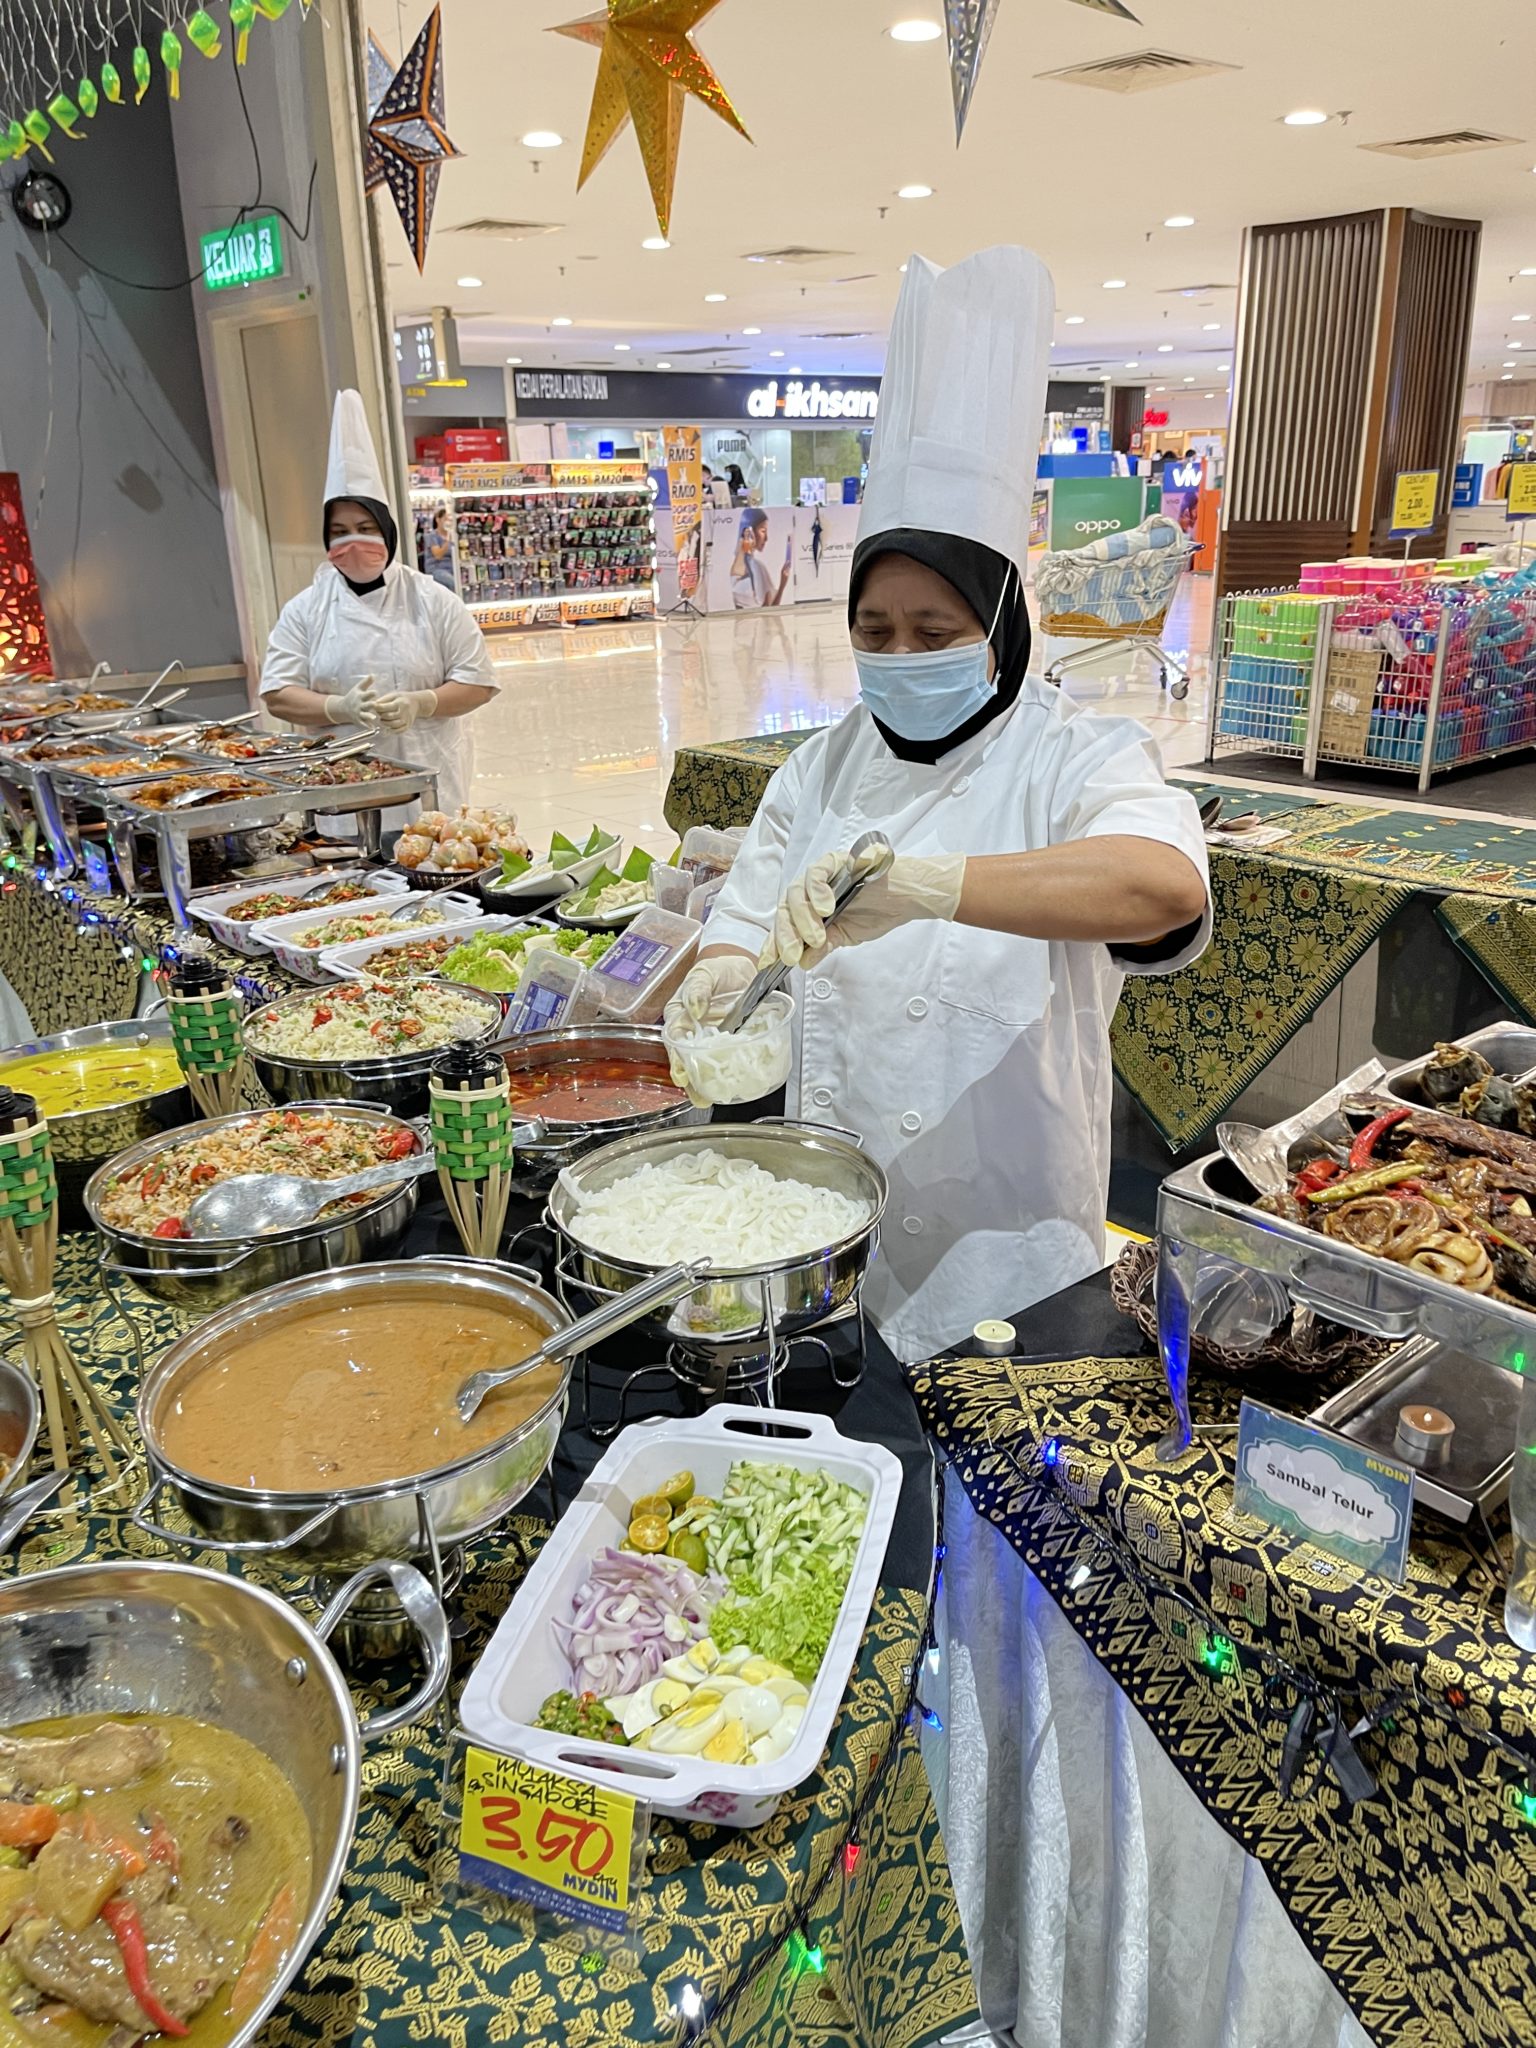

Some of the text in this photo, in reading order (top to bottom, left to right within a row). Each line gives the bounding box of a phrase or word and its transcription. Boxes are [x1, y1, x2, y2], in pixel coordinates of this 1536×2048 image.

[204, 233, 258, 281] KELUAR
[515, 373, 608, 399] KEDAI PERALATAN SUKAN
[668, 448, 695, 462] RM15
[717, 439, 747, 452] PUMA
[559, 474, 622, 485] RM15 RM20
[1172, 463, 1203, 487] viv
[713, 516, 733, 525] vivo
[1074, 519, 1121, 534] oppo
[492, 609, 522, 622] CABLE
[568, 602, 618, 616] FREE CABLE
[1365, 1457, 1410, 1486] MYDIN
[1266, 1462, 1374, 1519] Sambal Telur
[482, 1771, 608, 1820] SINGAPORE
[481, 1796, 614, 1876] 3.50
[563, 1871, 618, 1904] MYDIN
